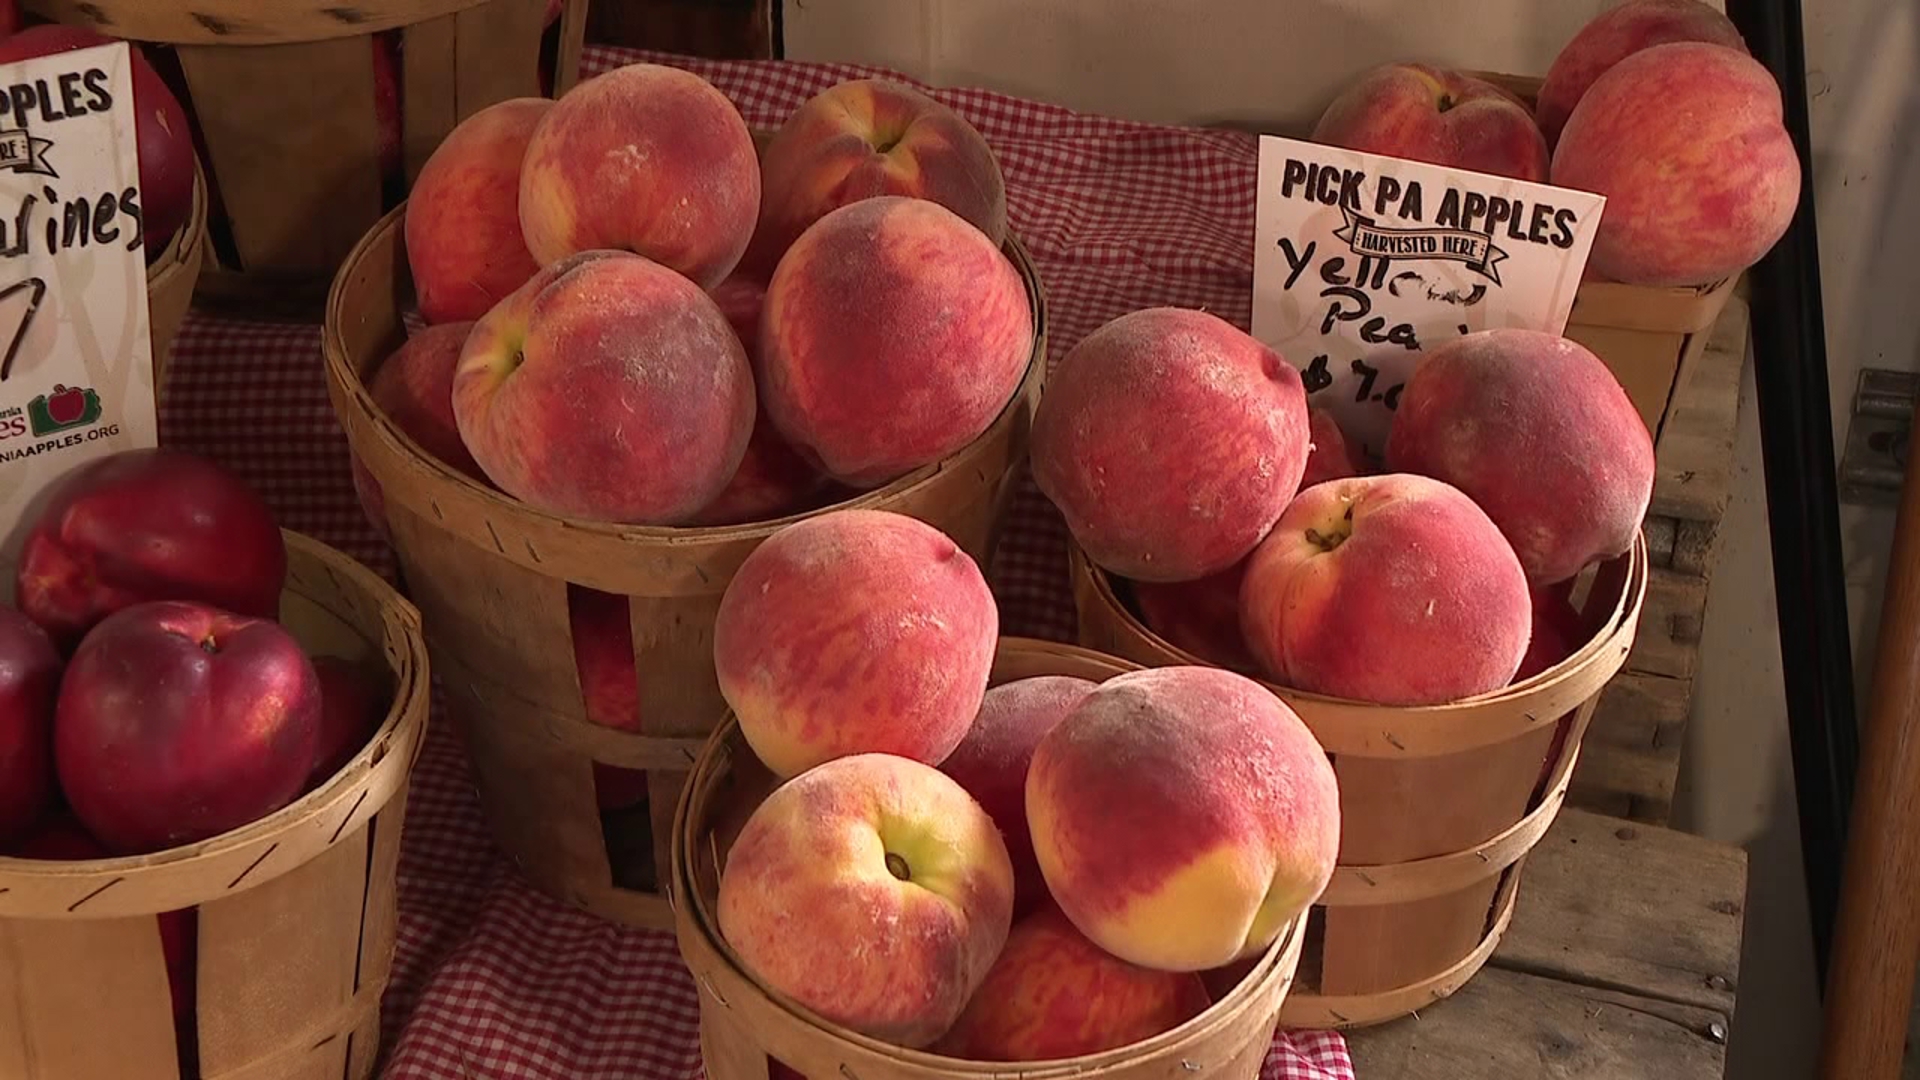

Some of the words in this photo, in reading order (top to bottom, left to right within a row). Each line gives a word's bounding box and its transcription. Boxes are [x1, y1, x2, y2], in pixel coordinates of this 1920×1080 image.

[0, 185, 143, 258] rines
[1281, 158, 1366, 211] PICK
[1374, 176, 1422, 222] PA
[1435, 188, 1578, 249] APPLES
[1361, 232, 1437, 253] HARVESTED
[1442, 236, 1479, 257] HERE
